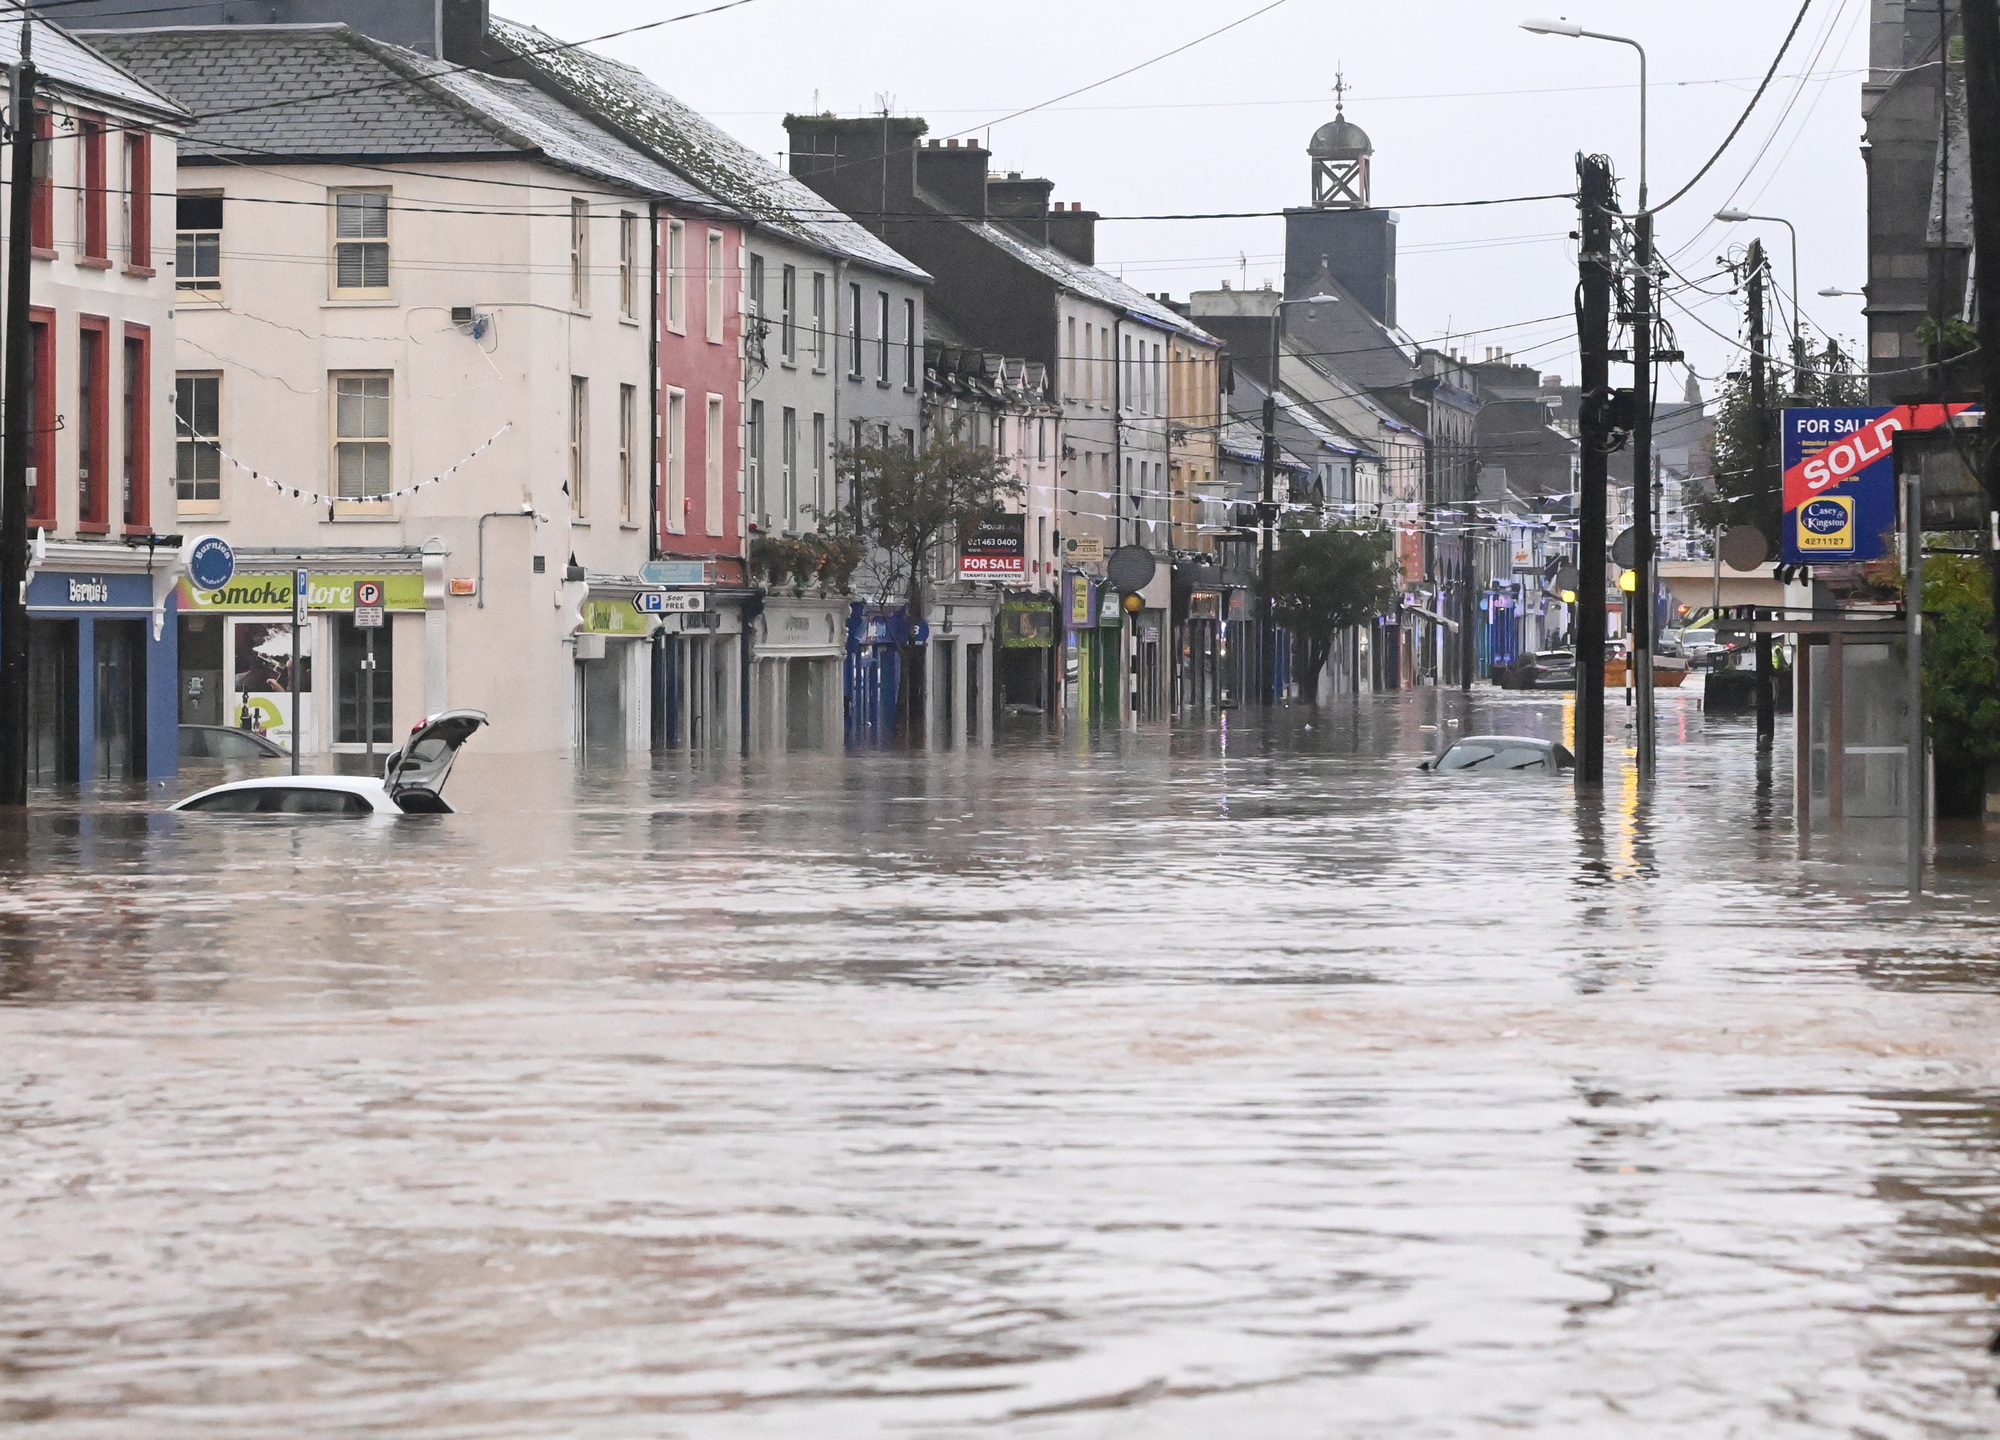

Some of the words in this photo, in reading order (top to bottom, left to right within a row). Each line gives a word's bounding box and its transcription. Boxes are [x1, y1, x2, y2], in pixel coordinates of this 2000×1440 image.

[1797, 419, 1829, 433] FOR
[1803, 418, 1903, 489] SOLD
[1808, 503, 1837, 516] Casey
[1803, 518, 1845, 532] Kingston
[195, 542, 231, 560] Bernie's
[964, 558, 988, 569] FOR
[990, 558, 1021, 569] SALE
[69, 577, 108, 603] Bernie's
[306, 582, 352, 604] tore
[366, 586, 375, 601] P
[649, 595, 660, 608] P
